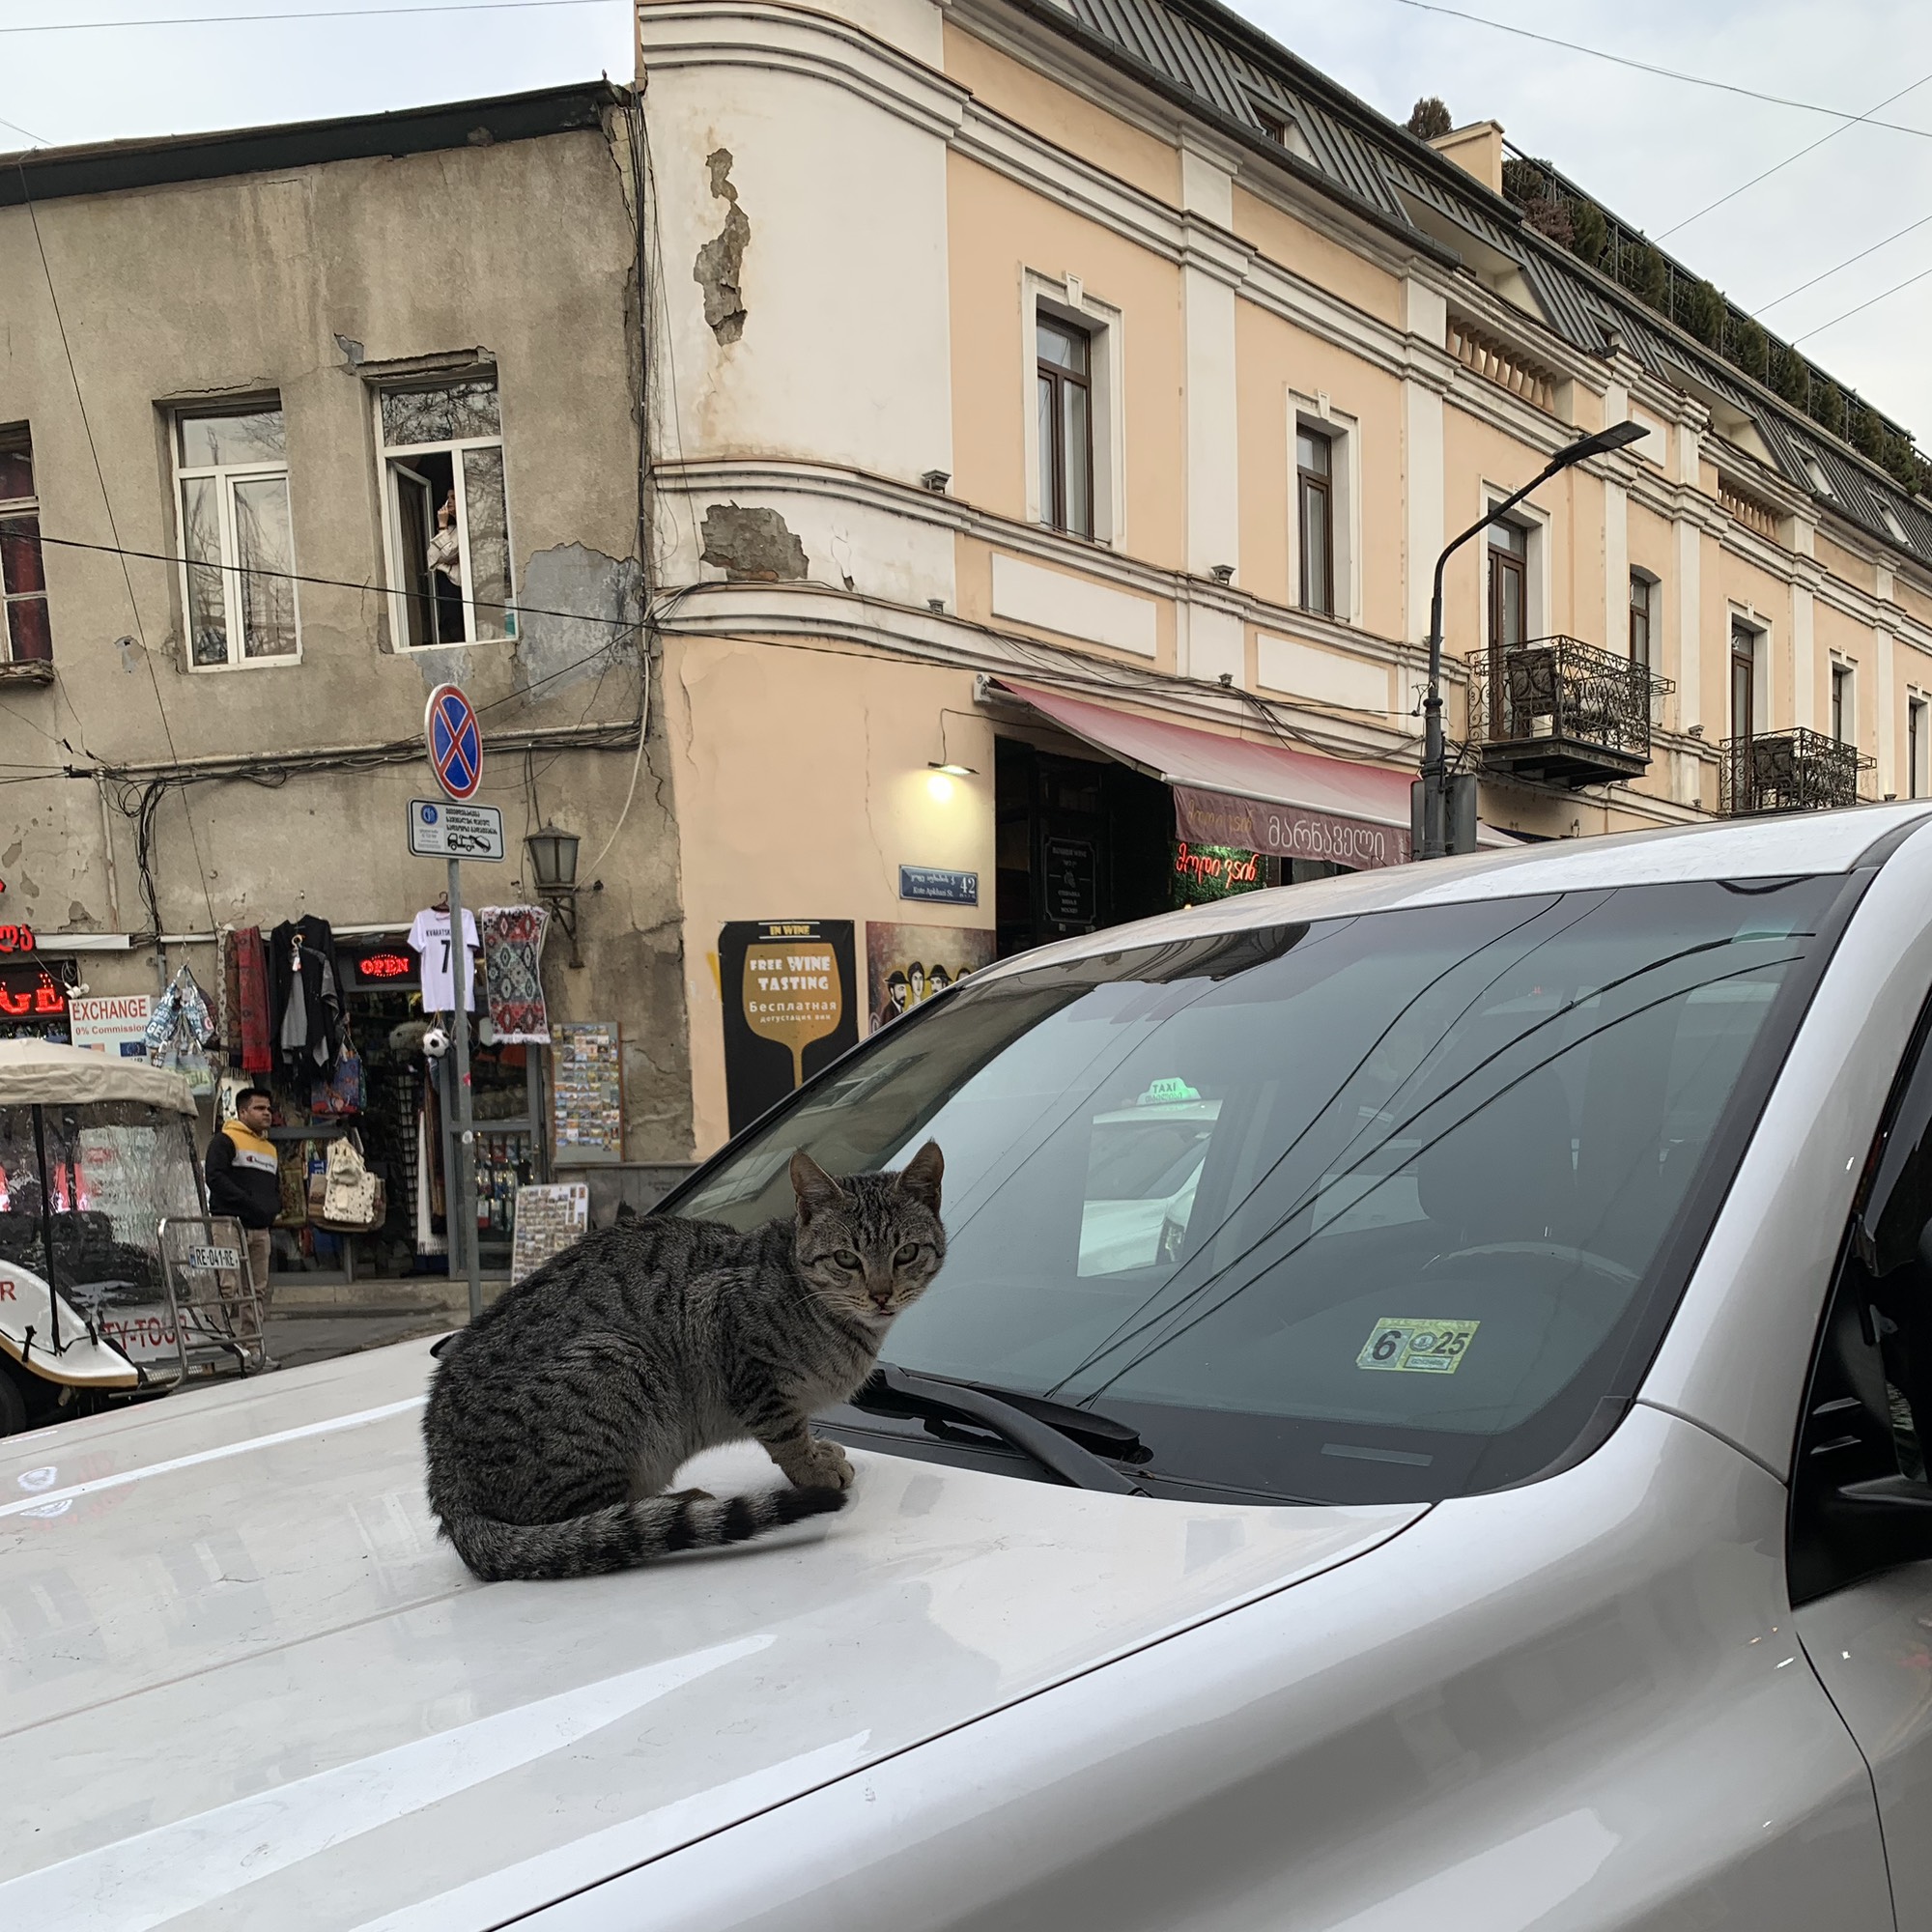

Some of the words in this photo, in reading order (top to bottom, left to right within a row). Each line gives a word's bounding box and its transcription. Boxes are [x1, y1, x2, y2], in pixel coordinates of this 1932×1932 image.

[959, 876, 976, 895] 42
[769, 925, 781, 935] IN
[782, 924, 810, 935] WINE
[440, 939, 451, 974] 7
[750, 959, 782, 971] FREE
[787, 956, 831, 972] WINE
[360, 958, 410, 975] OPEN
[757, 976, 829, 991] TASTING
[72, 999, 148, 1021] EXCHANGE
[749, 1001, 838, 1012] Бесплатная
[75, 1027, 90, 1036] 0%
[1152, 1082, 1177, 1094] TAXI
[1372, 1330, 1402, 1361] 6
[1431, 1331, 1470, 1355] 25
